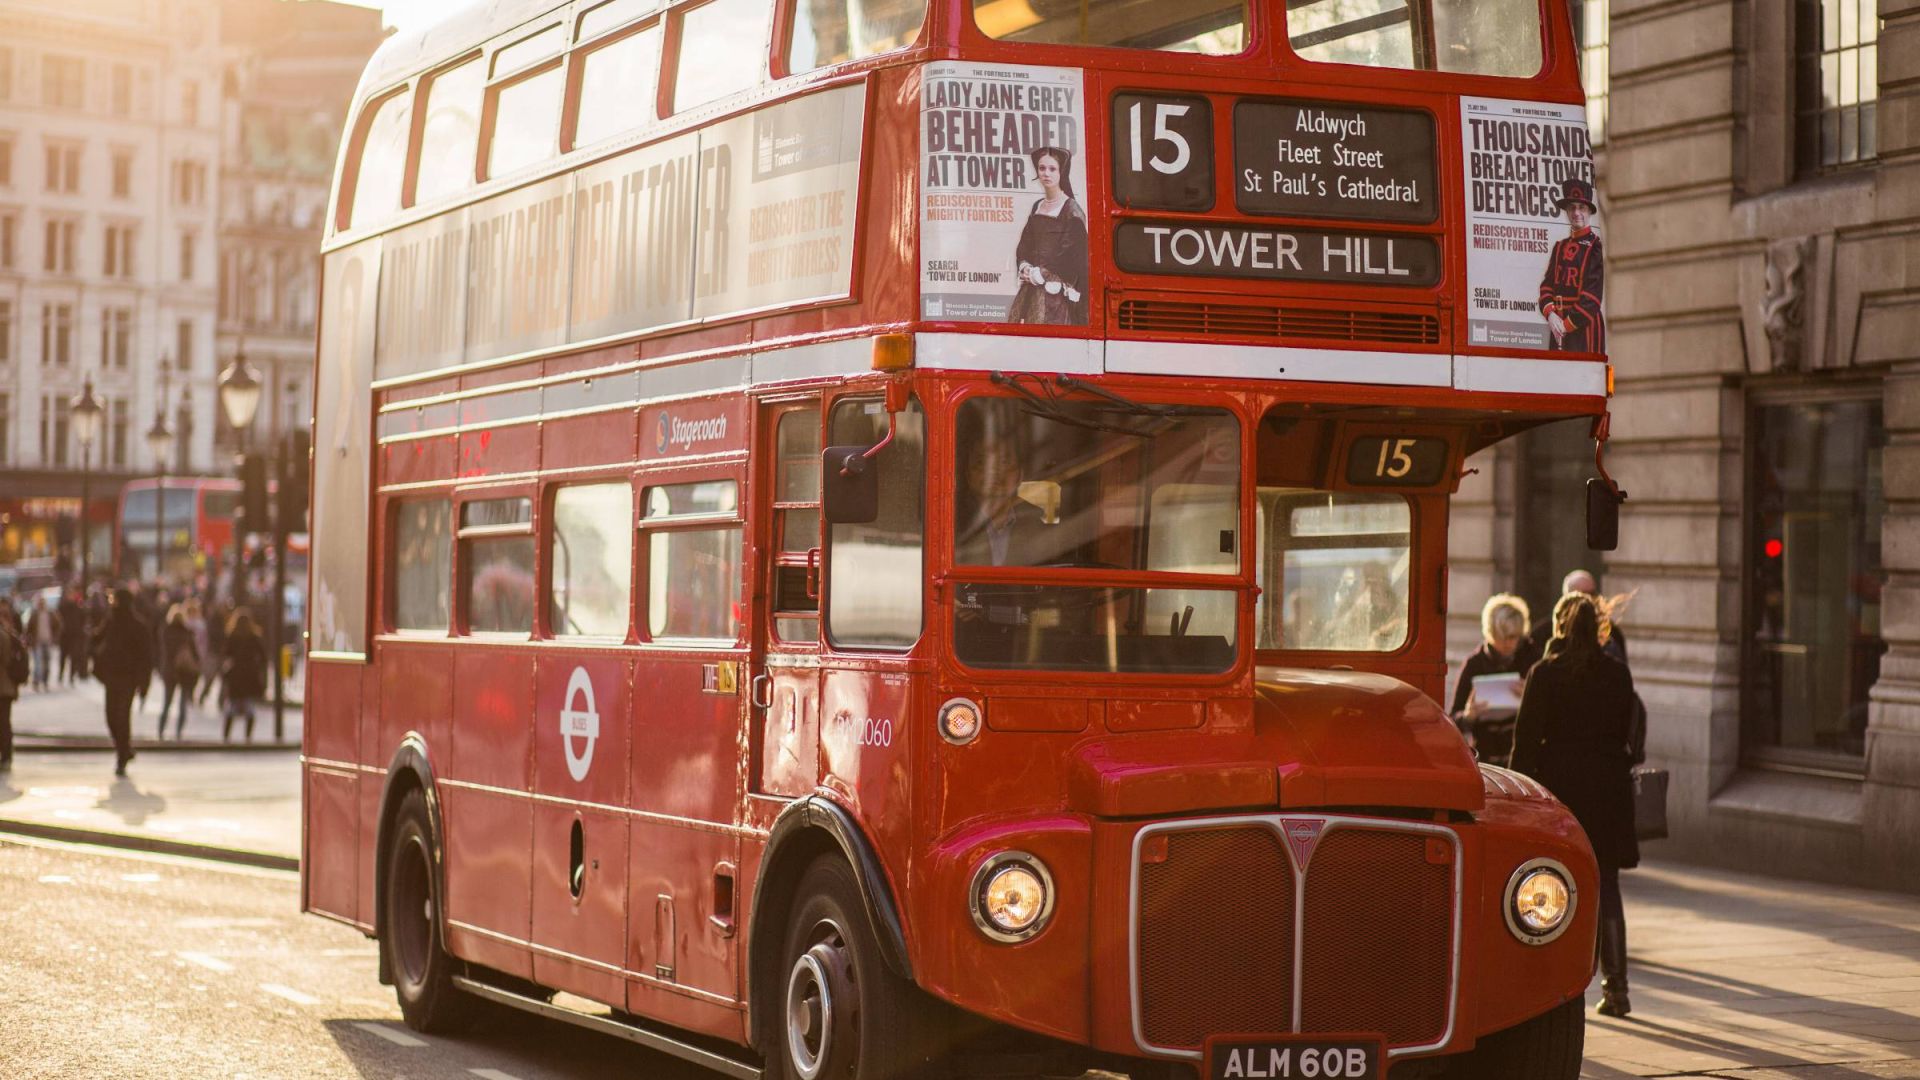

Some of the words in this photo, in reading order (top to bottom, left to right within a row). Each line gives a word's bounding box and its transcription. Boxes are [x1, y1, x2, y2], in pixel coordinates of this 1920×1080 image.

[984, 70, 1011, 78] FORTRESS
[926, 80, 973, 107] LADY
[975, 84, 1024, 110] JANE
[1028, 86, 1076, 113] GREY
[927, 110, 1077, 157] BEHEADED
[1129, 101, 1191, 174] 15
[1296, 109, 1366, 141] Aldwych
[1469, 119, 1593, 160] THOUSANDS
[1278, 139, 1321, 165] Fleet
[1333, 142, 1384, 169] Street
[1471, 152, 1536, 184] BREACH
[927, 155, 952, 187] AT
[955, 156, 1026, 189] TOWER
[1244, 168, 1262, 193] St
[1273, 171, 1327, 198] Paul's
[1337, 175, 1420, 203] Cathedral
[927, 195, 992, 209] REDISCOVER
[994, 196, 1014, 209] THE
[927, 208, 965, 222] MIGHTY
[967, 208, 1014, 223] FORTRESS
[1473, 181, 1561, 218] DEFENCES
[614, 170, 645, 317] AT
[645, 143, 732, 309] TOWER
[750, 195, 817, 244] REDISCOVER
[819, 190, 845, 230] THE
[1473, 224, 1530, 240] REDISCOVER
[1531, 227, 1549, 241] THE
[748, 246, 785, 288] MIGHTY
[785, 235, 841, 279] FORTRESS
[1144, 227, 1302, 271] TOWER
[1323, 236, 1409, 276] HILL
[1473, 237, 1507, 251] MIGHTY
[1508, 239, 1549, 254] FORTRESS
[928, 260, 959, 271] SEARCH
[958, 272, 967, 282] OF
[1474, 287, 1501, 299] SEARCH
[1500, 299, 1508, 310] OF
[978, 310, 1006, 318] London
[1519, 337, 1542, 345] London
[670, 412, 727, 451] Stagecoach
[1376, 439, 1417, 478] 15
[1224, 1048, 1290, 1078] ALM
[1300, 1048, 1367, 1078] 60B
